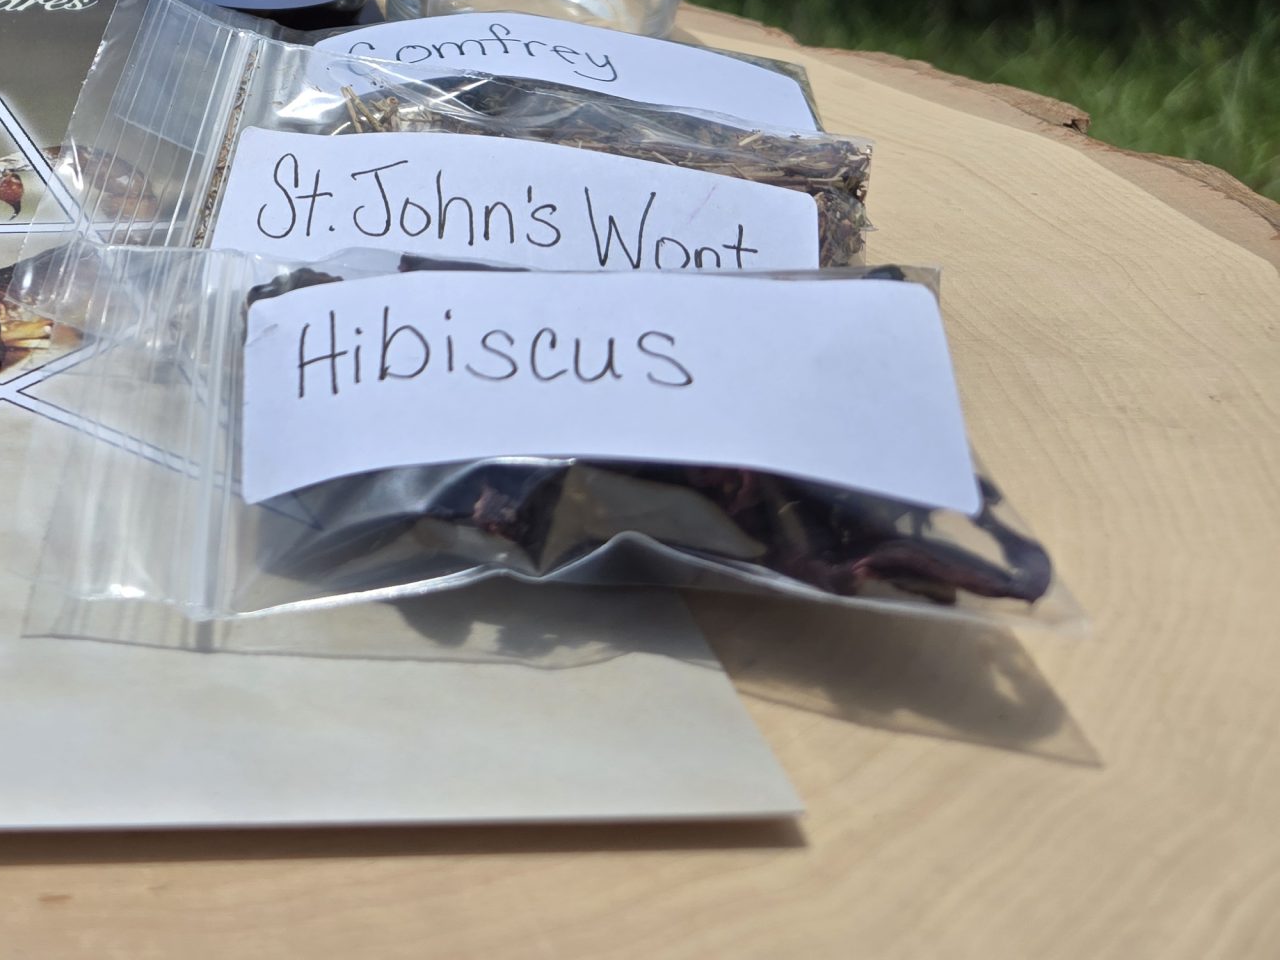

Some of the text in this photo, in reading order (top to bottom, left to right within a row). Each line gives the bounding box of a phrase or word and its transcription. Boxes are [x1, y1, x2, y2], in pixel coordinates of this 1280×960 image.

[348, 23, 618, 82] Comfrey
[257, 153, 335, 238] St.
[351, 160, 562, 246] John's
[297, 306, 693, 398] Hibiscus
